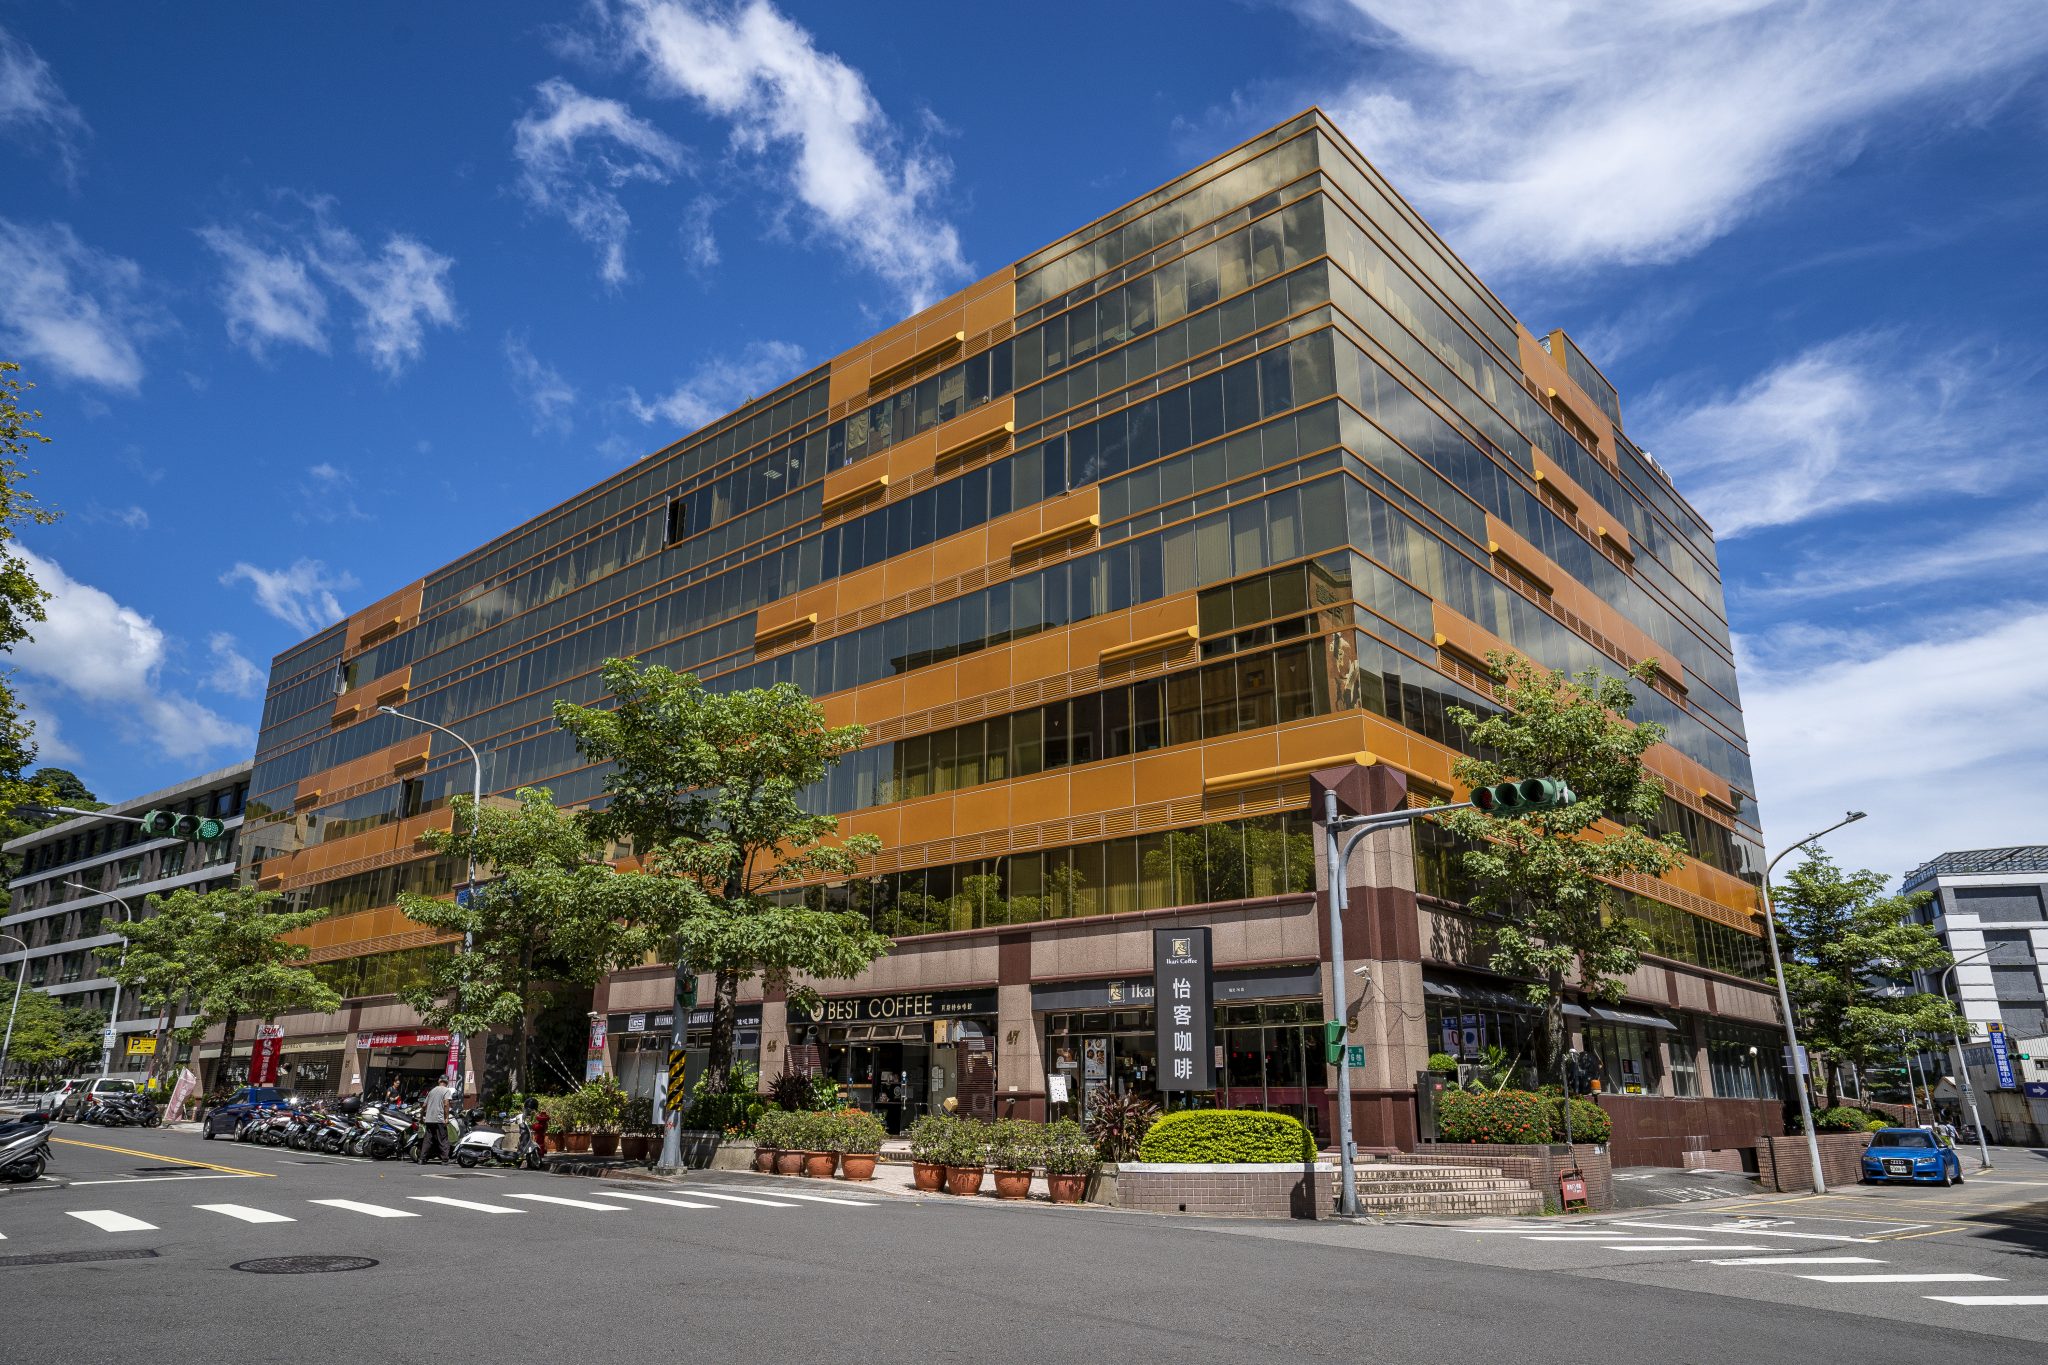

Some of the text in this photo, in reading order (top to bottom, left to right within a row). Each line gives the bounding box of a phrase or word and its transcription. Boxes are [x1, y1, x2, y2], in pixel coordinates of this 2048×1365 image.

[828, 995, 933, 1020] BEST COFFEE
[1007, 1030, 1020, 1045] 47
[1172, 978, 1193, 1080] 怡客咖啡
